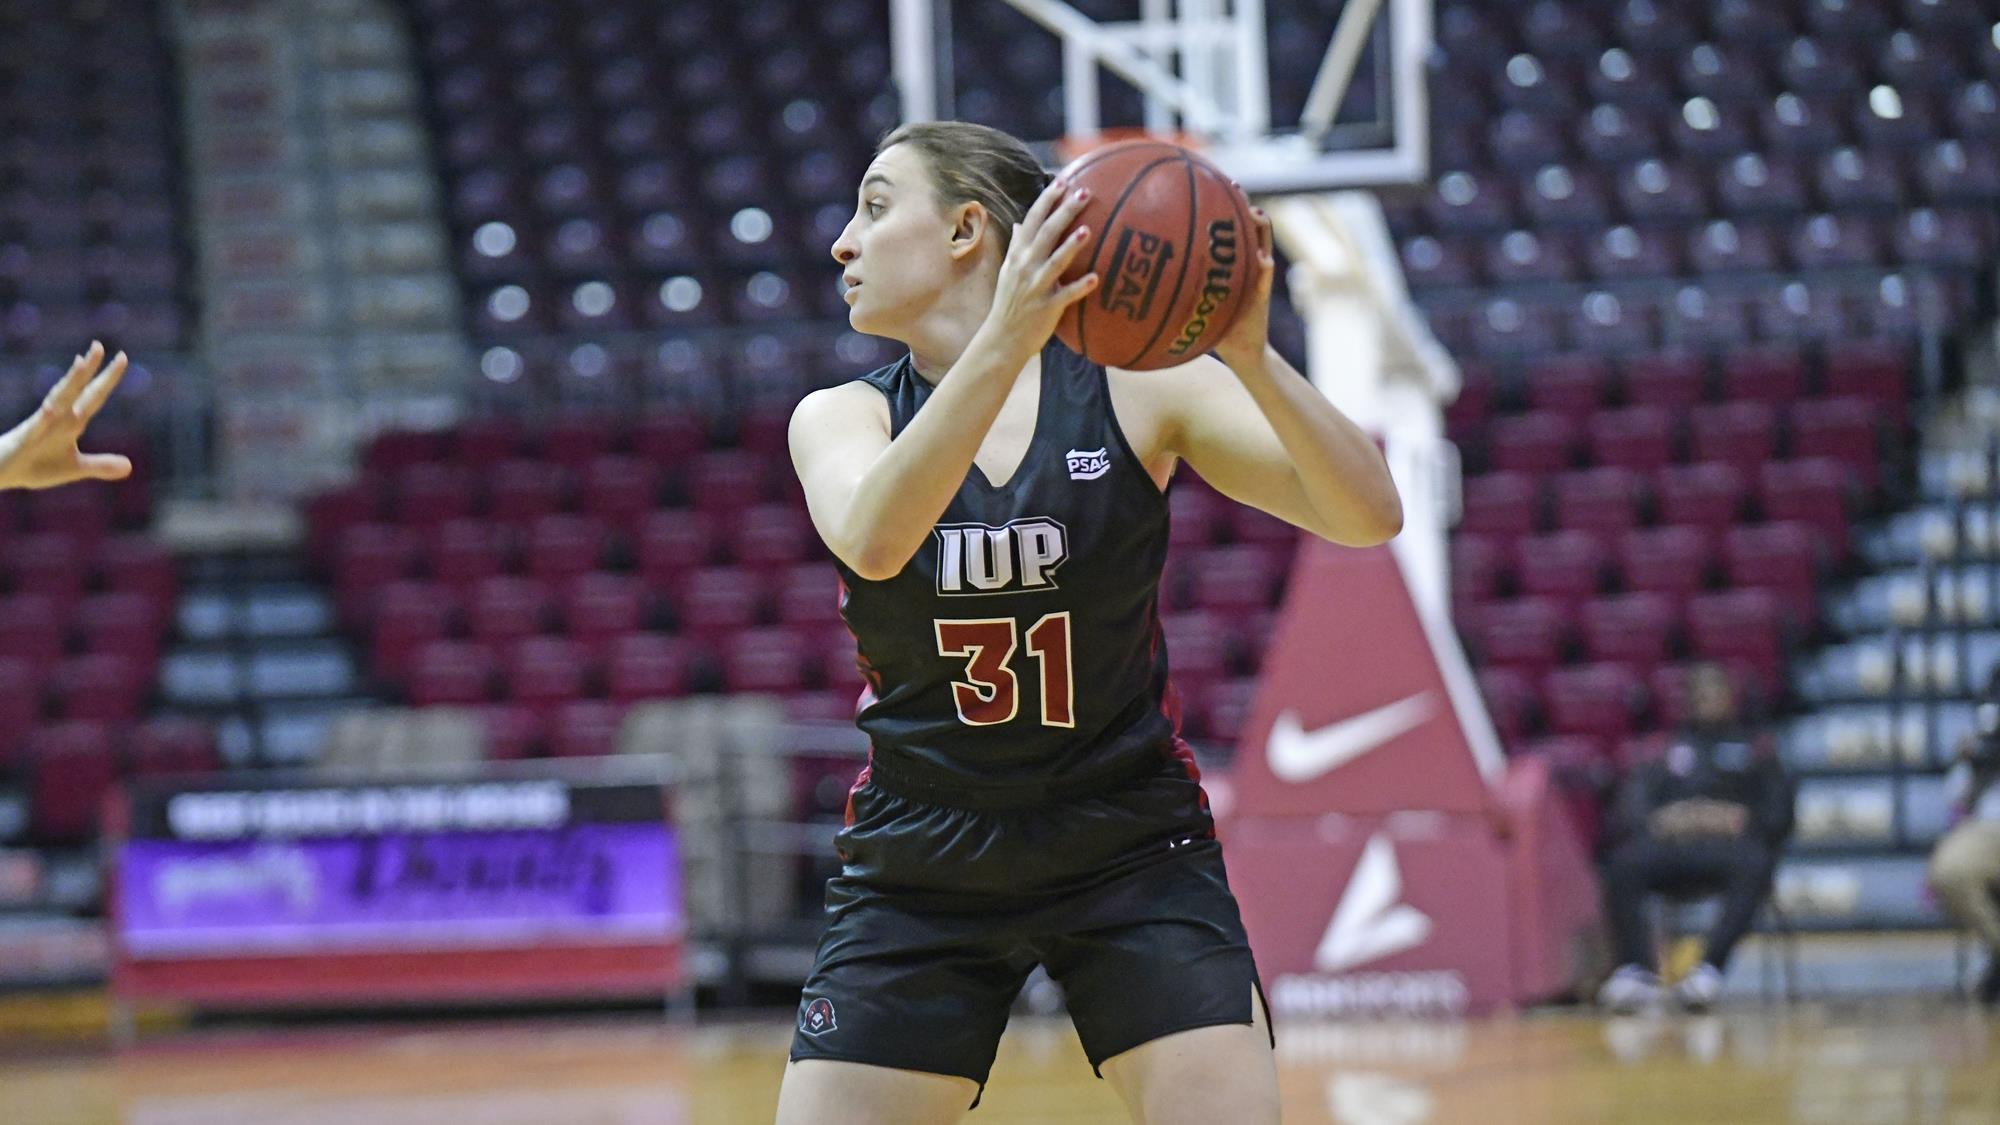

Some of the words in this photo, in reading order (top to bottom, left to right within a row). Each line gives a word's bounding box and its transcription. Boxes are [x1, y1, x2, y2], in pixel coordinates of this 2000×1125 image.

[1110, 229, 1161, 321] PSAC
[1168, 219, 1237, 356] Wilson
[1067, 451, 1110, 475] PSAC
[938, 521, 1065, 592] IUP
[933, 611, 1075, 728] 31
